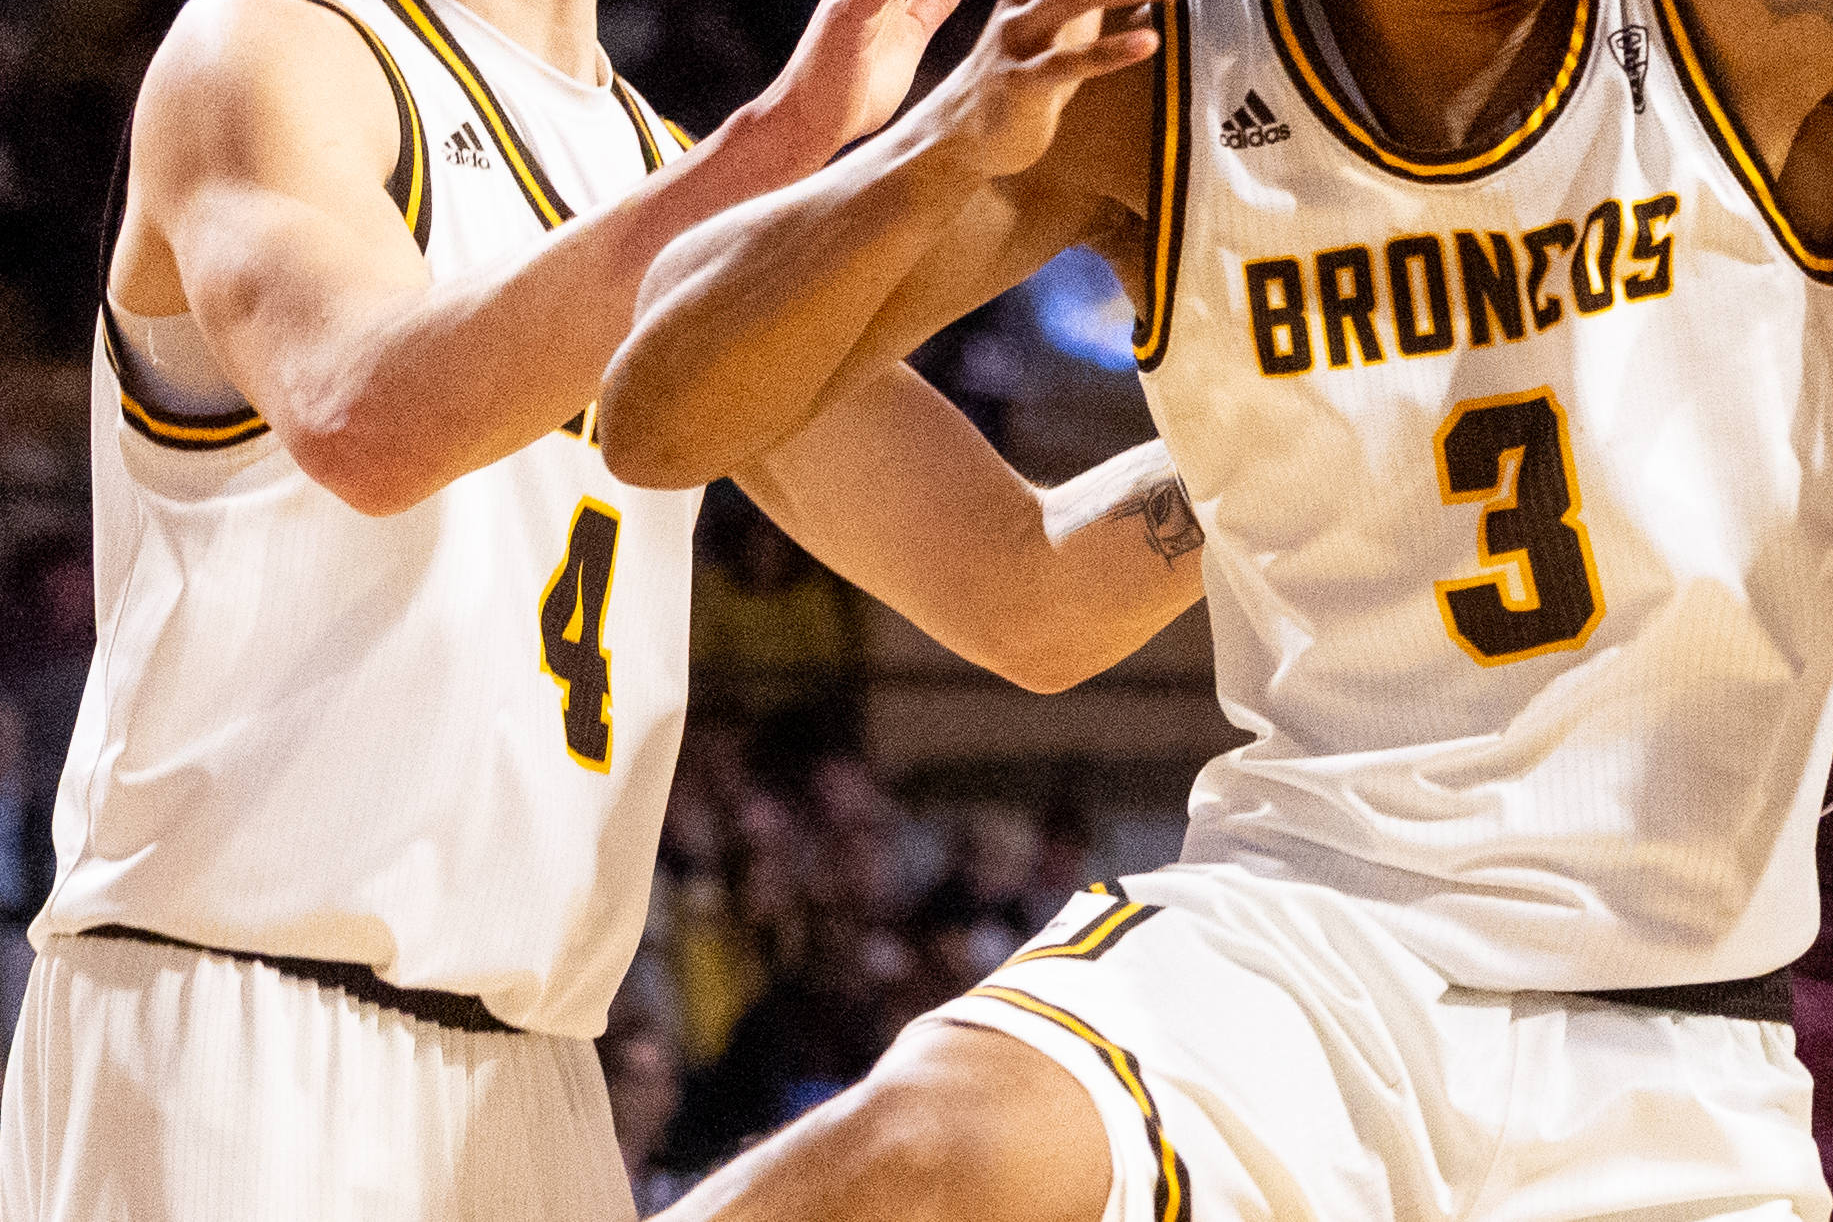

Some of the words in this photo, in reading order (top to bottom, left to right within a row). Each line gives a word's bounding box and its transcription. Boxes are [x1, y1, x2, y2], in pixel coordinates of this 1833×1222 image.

[1221, 123, 1291, 149] adidas
[1244, 192, 1680, 378] BRONCOS
[538, 494, 622, 774] 4
[1432, 386, 1606, 668] 3
